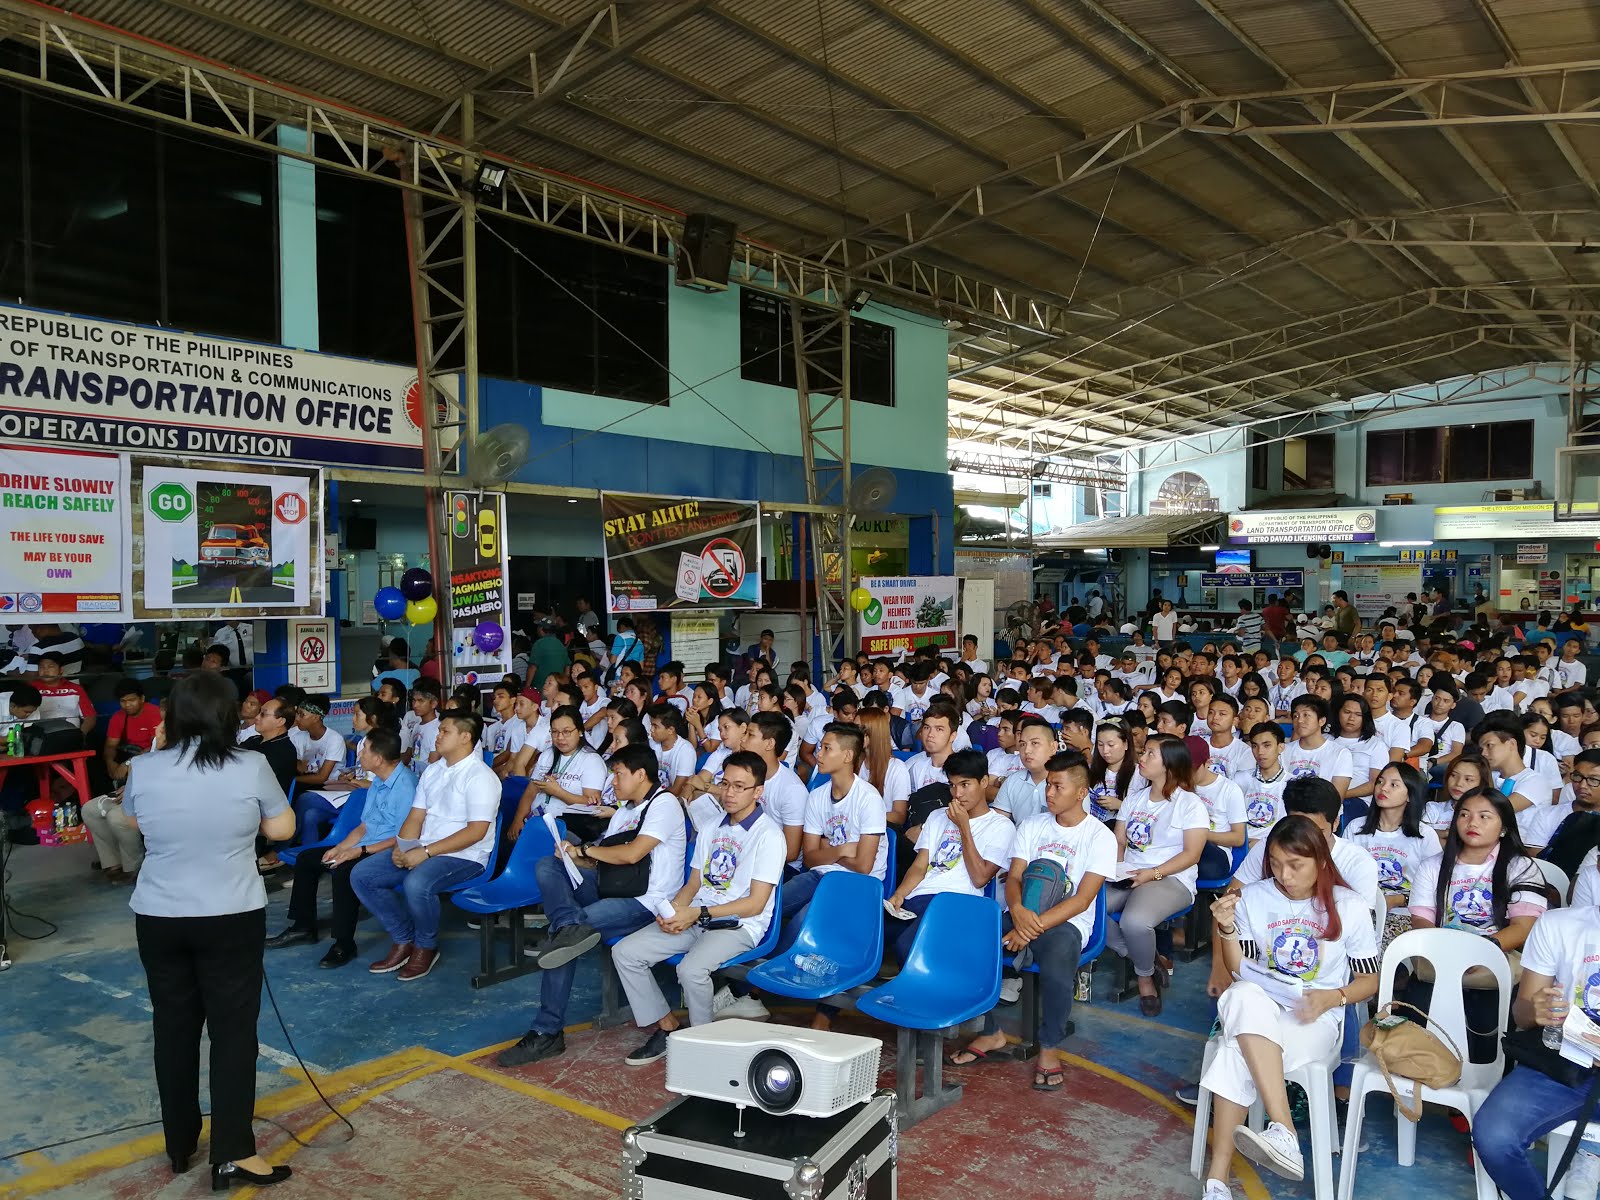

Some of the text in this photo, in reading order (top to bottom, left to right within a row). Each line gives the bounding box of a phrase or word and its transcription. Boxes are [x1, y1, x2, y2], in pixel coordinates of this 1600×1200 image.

[0, 314, 293, 369] REPUBLIC OF THE PHILIPPINES
[10, 340, 392, 402] OF TRANSPORTATION & COMMUNICATIONS
[296, 397, 393, 434] OFFICE
[0, 414, 292, 457] OPERATIONS DIVISION
[0, 473, 114, 494] DRIVE SLOWLY
[222, 489, 231, 497] 80
[237, 490, 249, 498] 100
[3, 493, 115, 512] REACH SAFELY
[158, 494, 186, 511] GO
[204, 520, 214, 528] 20
[604, 501, 700, 537] STAY ALIVE!
[627, 529, 661, 547] DON'T
[663, 524, 685, 538] TEXT
[687, 519, 708, 532] AND
[1266, 525, 1328, 533] TRANSPORTATION
[1329, 524, 1354, 532] OFFICE
[10, 531, 105, 544] THE LIFE YOU SAVE
[1247, 533, 1354, 543] METRO DAVAO LICENSING CENTER
[23, 552, 92, 563] MAY BE YOUR
[46, 568, 72, 578] OWN
[451, 578, 503, 595] PAGMANEHO
[870, 580, 877, 588] BE
[882, 579, 900, 588] SMART
[900, 579, 917, 588] DRIVER
[452, 590, 499, 607] LUWAS NA
[882, 595, 914, 605] WEAR YOUR
[452, 600, 502, 618] PASAHERO
[887, 607, 911, 617] HELMETS
[881, 619, 915, 630] AT ALL TIMES
[870, 639, 888, 652] SAFE
[1267, 920, 1281, 930] ROAD
[1282, 917, 1301, 926] SAFETY
